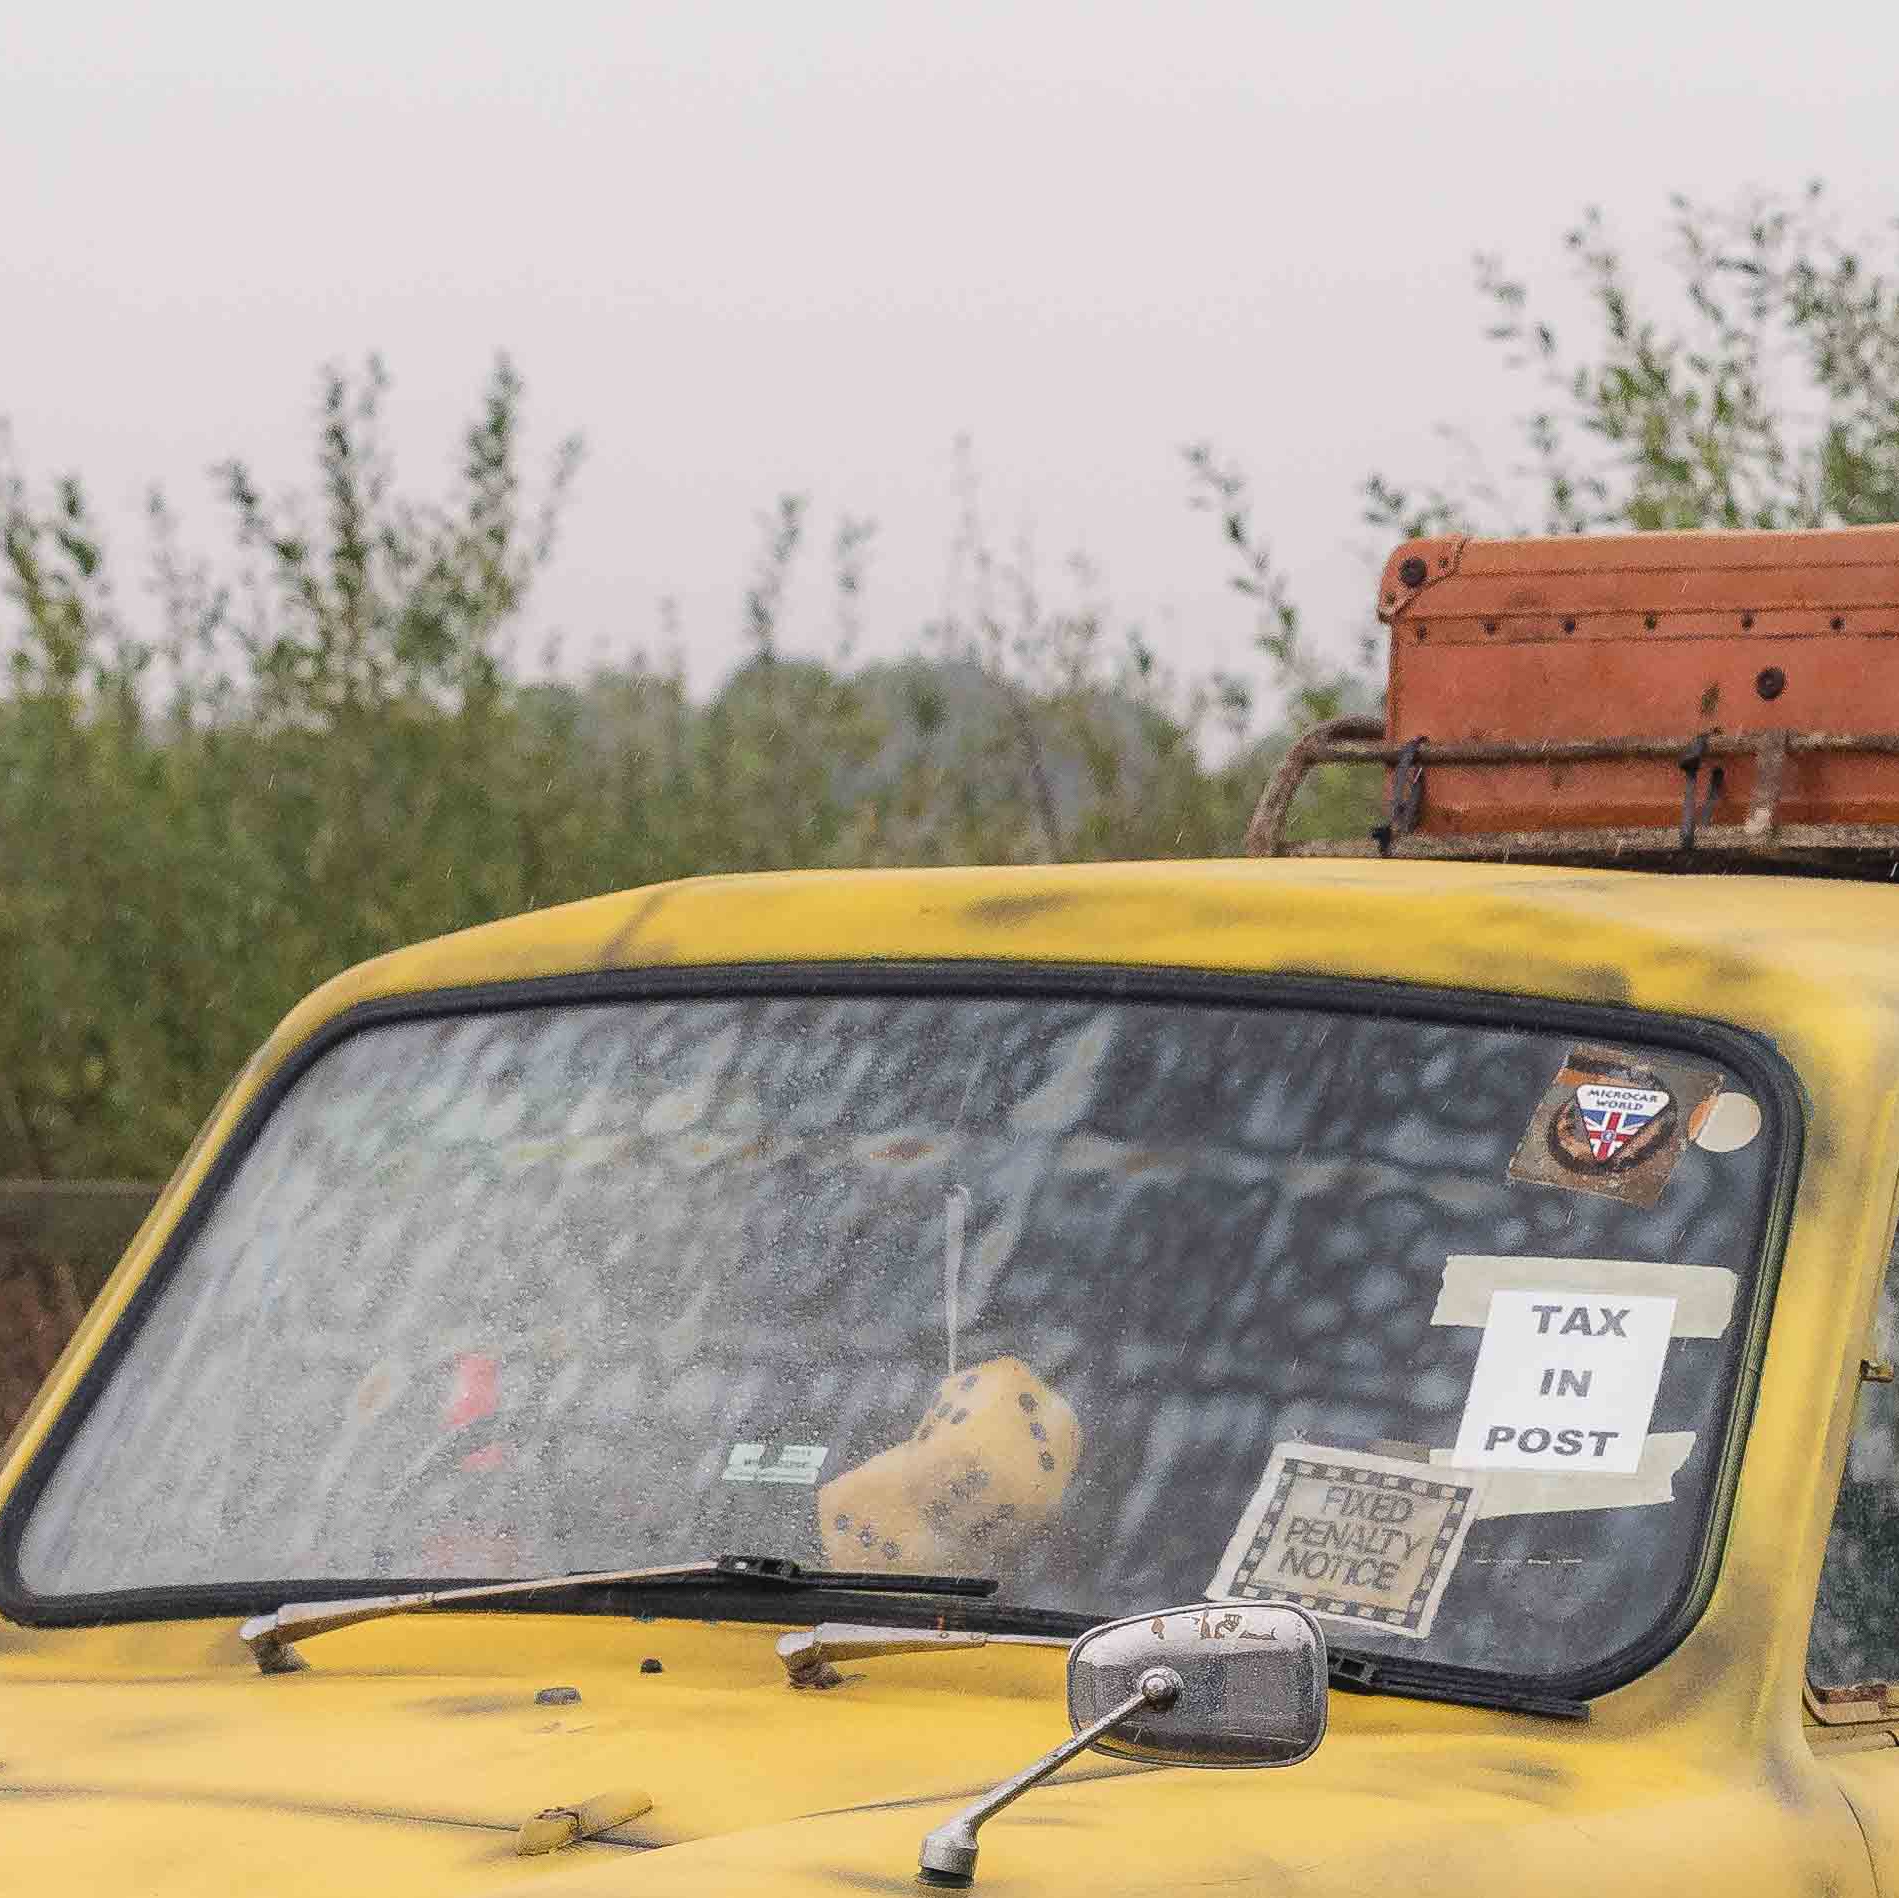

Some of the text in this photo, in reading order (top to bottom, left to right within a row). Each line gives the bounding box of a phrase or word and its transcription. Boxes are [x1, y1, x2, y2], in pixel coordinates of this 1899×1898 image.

[1589, 1089, 1659, 1104] MICROCAR
[1597, 1099, 1644, 1111] WORLD
[1531, 1304, 1631, 1337] TAX
[1539, 1368, 1592, 1398] IN
[1483, 1425, 1619, 1457] POST
[1324, 1486, 1415, 1523] FIXED
[1284, 1516, 1425, 1560] PENALTY
[1277, 1548, 1400, 1592] NOTICE
